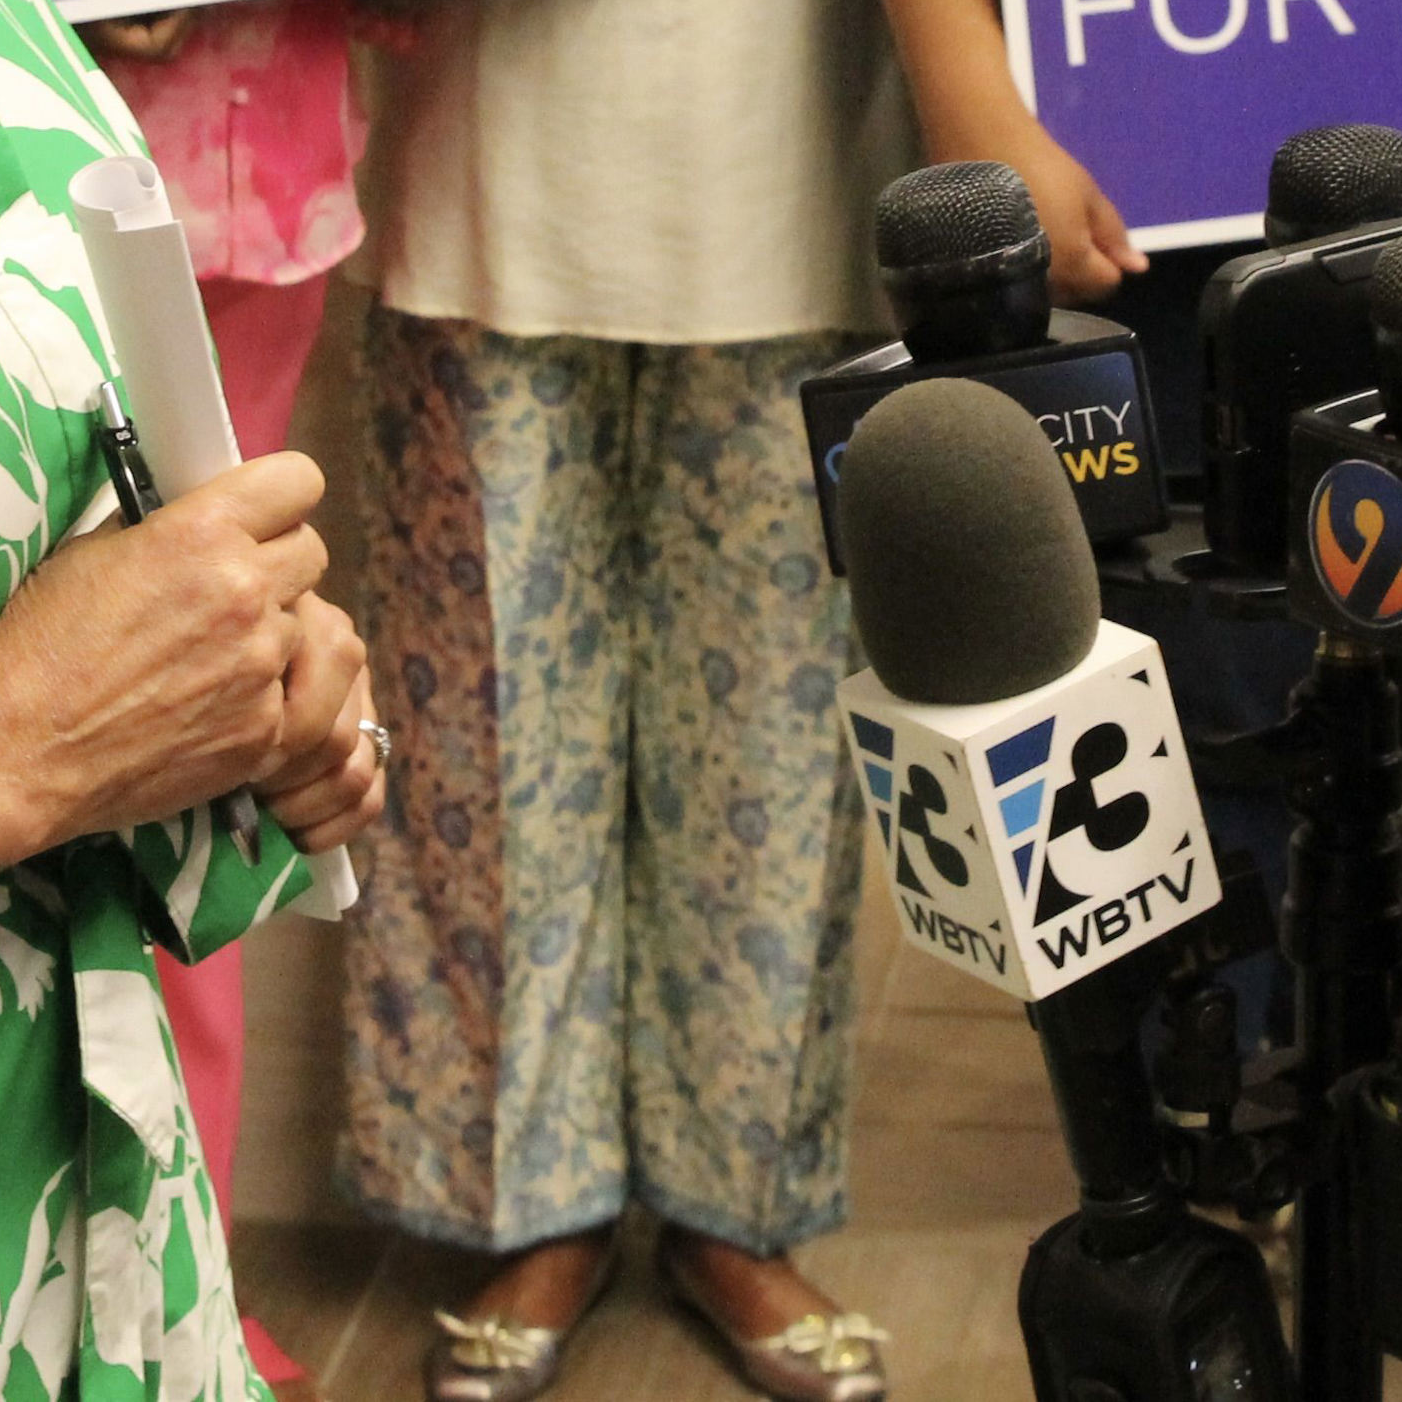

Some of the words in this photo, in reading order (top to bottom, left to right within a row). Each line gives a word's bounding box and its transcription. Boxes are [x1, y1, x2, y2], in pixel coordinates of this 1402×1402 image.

[1062, 442, 1140, 483] WS
[1033, 722, 1151, 928] 3
[901, 895, 1006, 976] WBTV
[1037, 857, 1195, 970] WBTV
